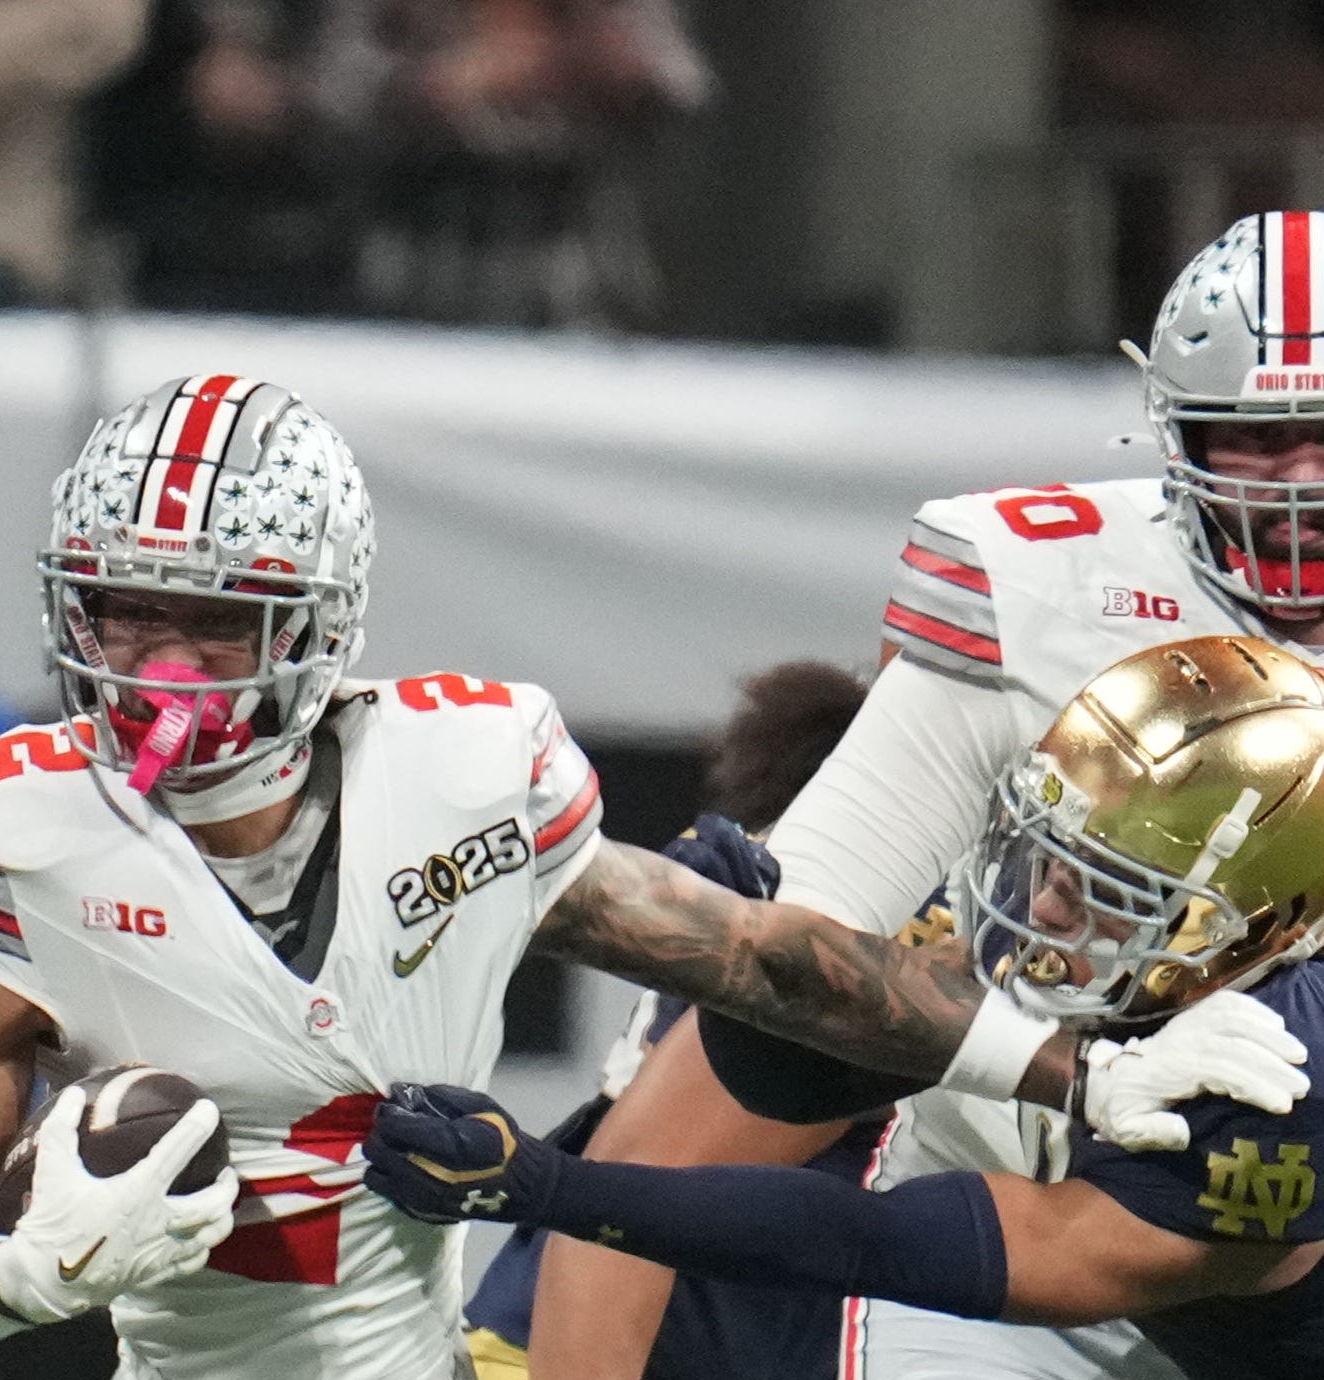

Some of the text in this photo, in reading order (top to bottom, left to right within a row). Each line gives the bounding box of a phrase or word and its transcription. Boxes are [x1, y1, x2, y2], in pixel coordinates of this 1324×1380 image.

[1256, 373, 1289, 391] OHIO
[396, 672, 513, 712] 2
[387, 817, 530, 929] 2025
